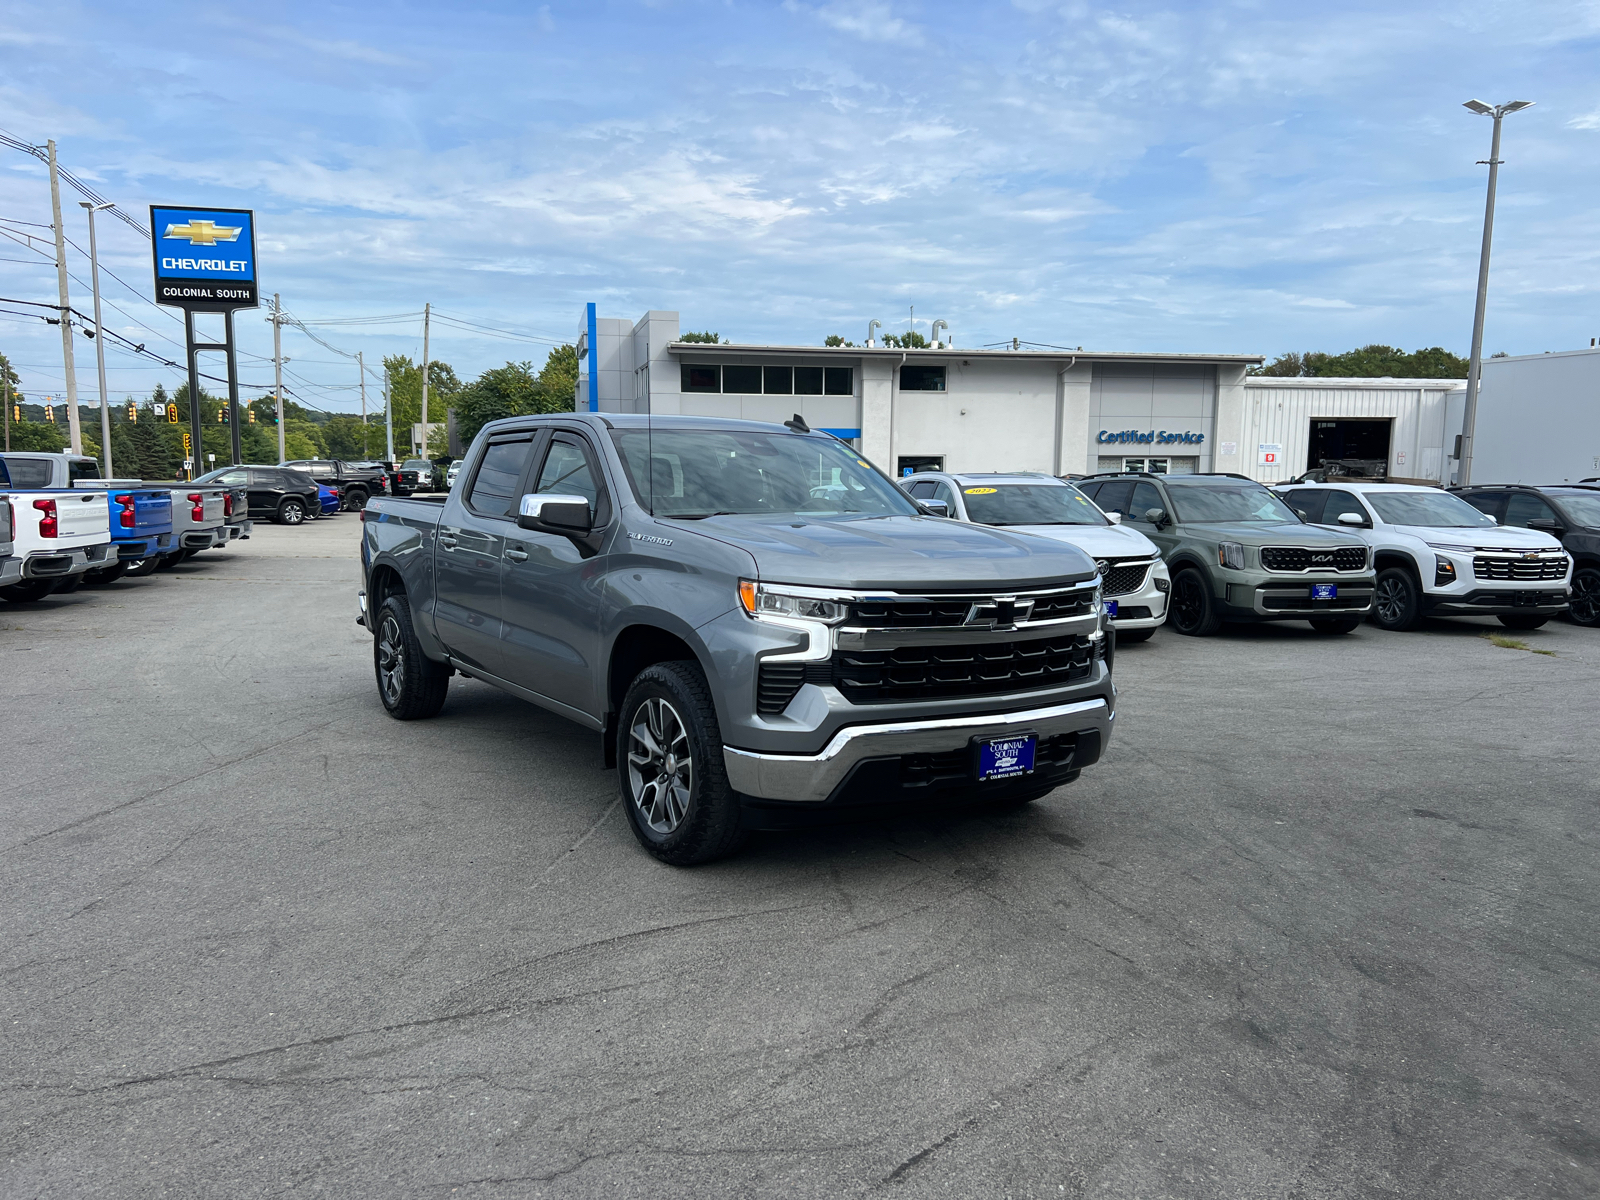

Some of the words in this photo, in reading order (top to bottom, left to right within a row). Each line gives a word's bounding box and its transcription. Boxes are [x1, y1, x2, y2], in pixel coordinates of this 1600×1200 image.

[162, 257, 248, 272] CHEVROLET
[163, 287, 214, 298] COLONIAL
[216, 289, 250, 299] SOUTH
[1098, 430, 1155, 443] Certified
[1158, 430, 1205, 443] Service
[626, 531, 674, 547] SILVERADO
[1311, 554, 1334, 562] KIA
[990, 741, 1024, 753] COLONIAL
[994, 749, 1019, 759] SOUTH
